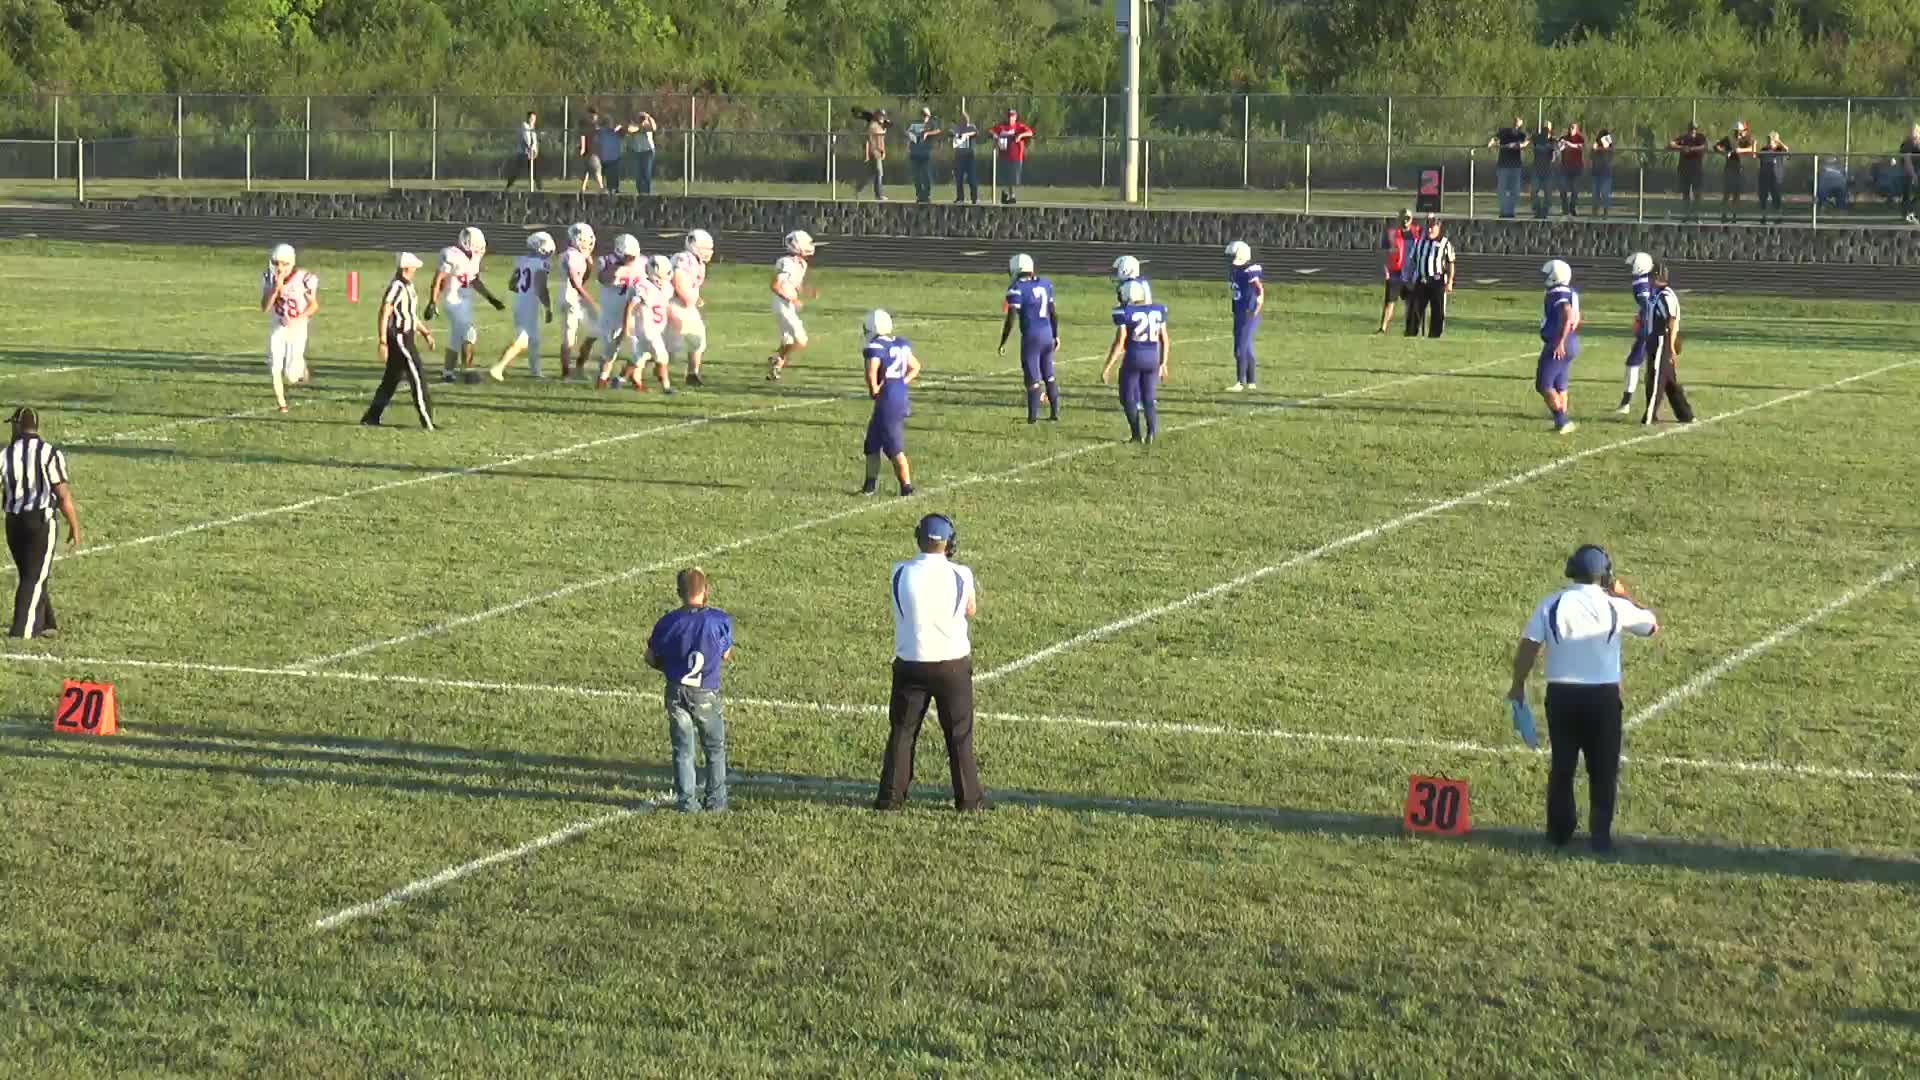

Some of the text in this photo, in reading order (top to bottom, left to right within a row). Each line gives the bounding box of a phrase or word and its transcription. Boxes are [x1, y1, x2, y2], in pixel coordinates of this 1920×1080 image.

[1421, 170, 1439, 195] 2
[652, 305, 663, 323] 5
[1033, 287, 1048, 318] 7
[681, 651, 704, 687] 2
[58, 687, 103, 729] 20
[1411, 783, 1460, 830] 30
